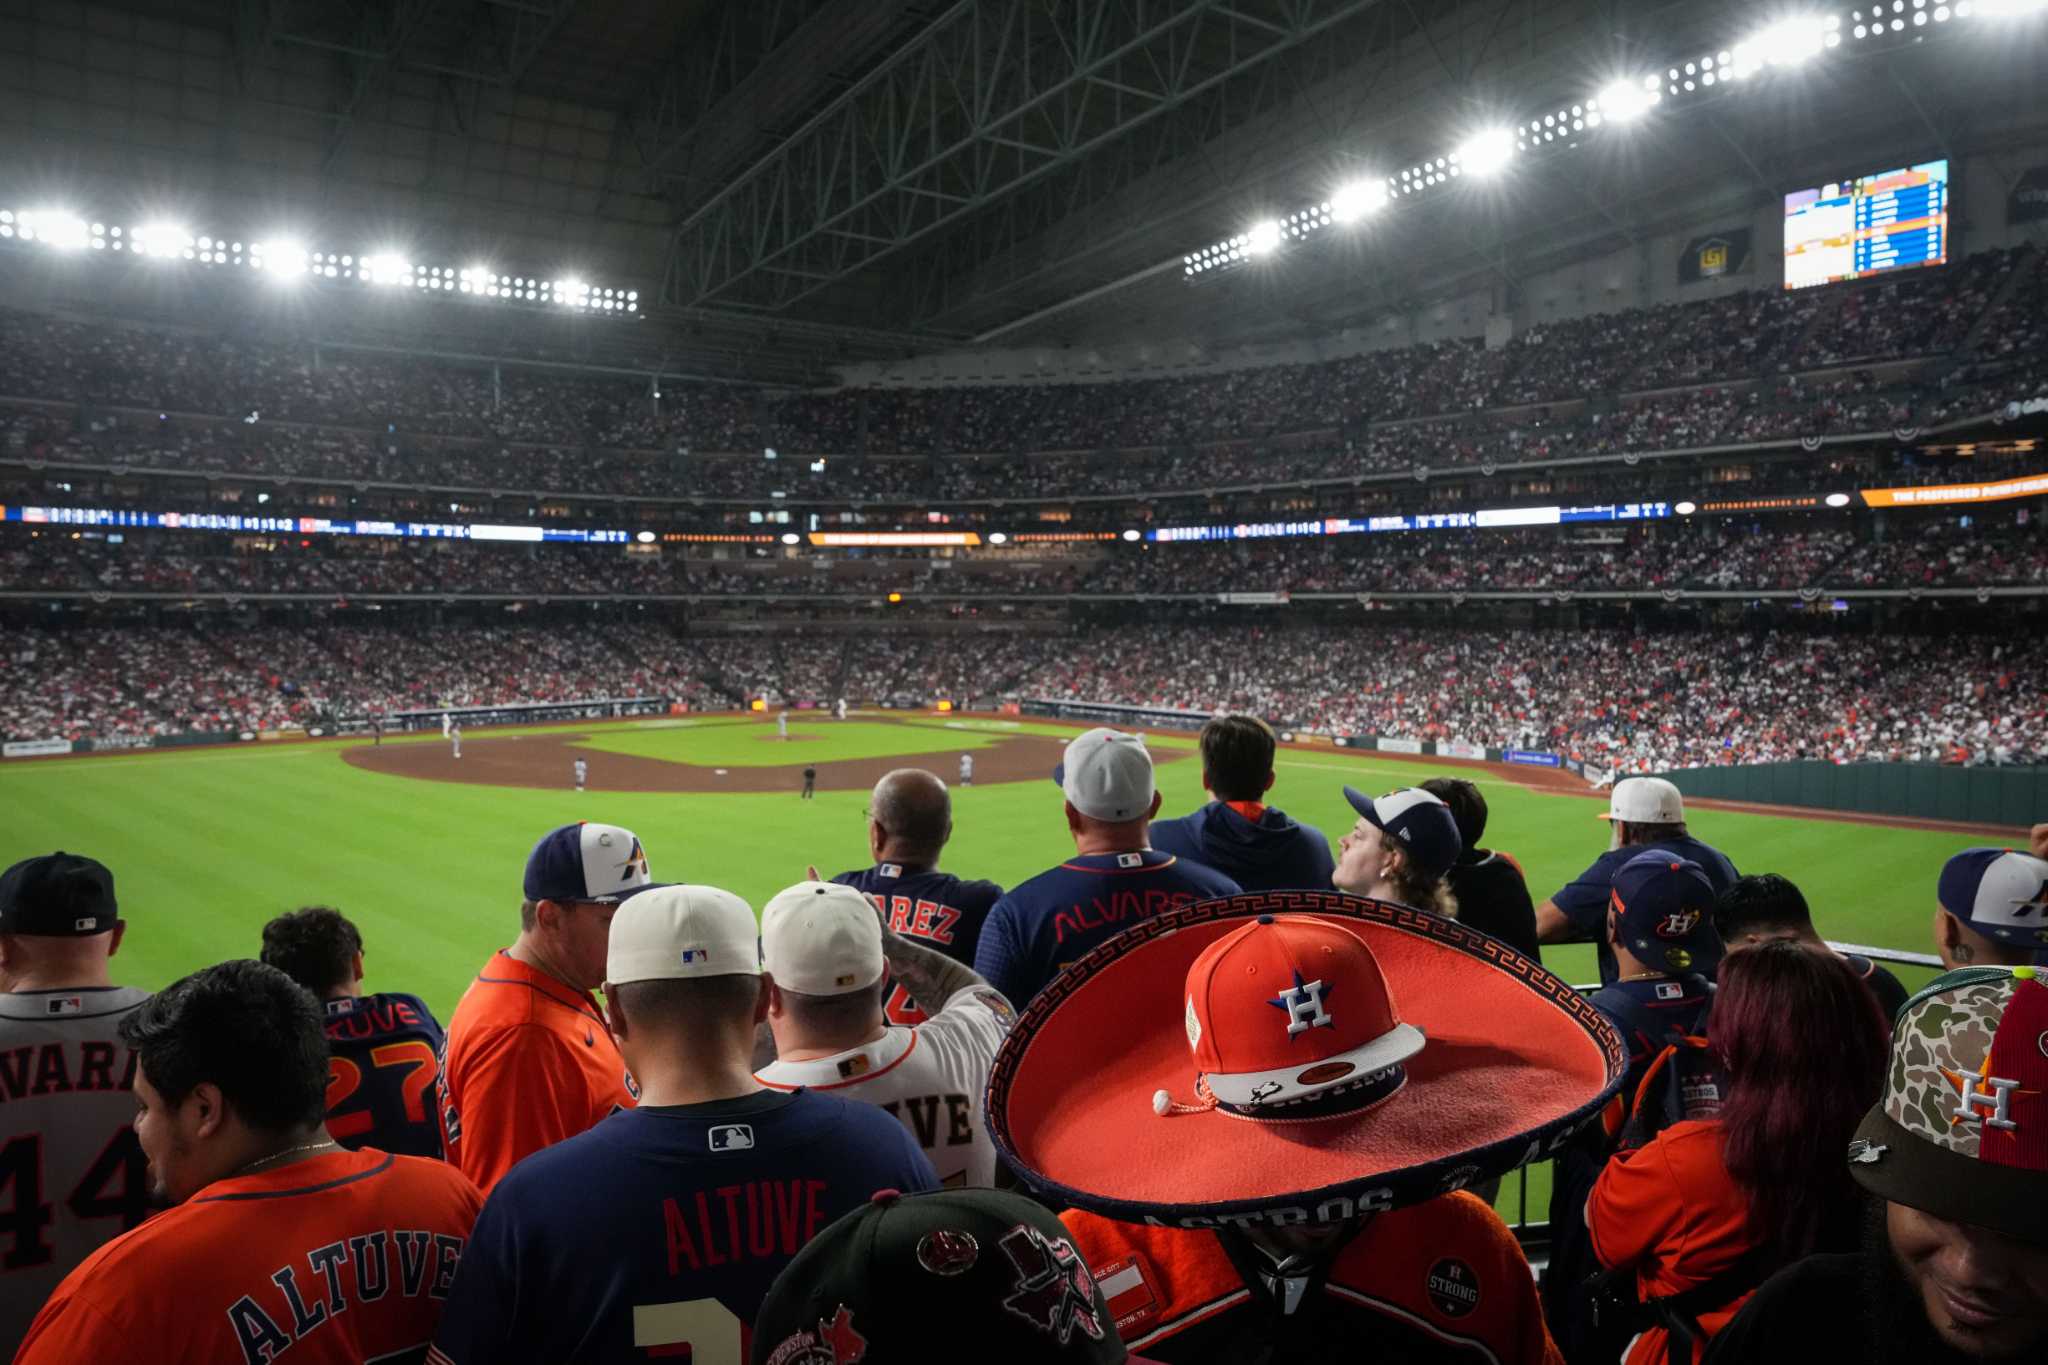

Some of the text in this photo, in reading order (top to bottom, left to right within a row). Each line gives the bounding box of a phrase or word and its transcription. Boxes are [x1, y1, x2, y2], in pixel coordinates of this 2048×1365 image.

[324, 1001, 422, 1040] TUVE
[1279, 980, 1332, 1034] H
[0, 1041, 138, 1101] VAR
[325, 1036, 437, 1136] 27
[1952, 1068, 2020, 1130] H
[881, 1094, 972, 1147] VE
[663, 1177, 827, 1280] ALTUVE
[226, 1230, 464, 1365] ALTUVE
[1428, 1274, 1478, 1302] STRONG
